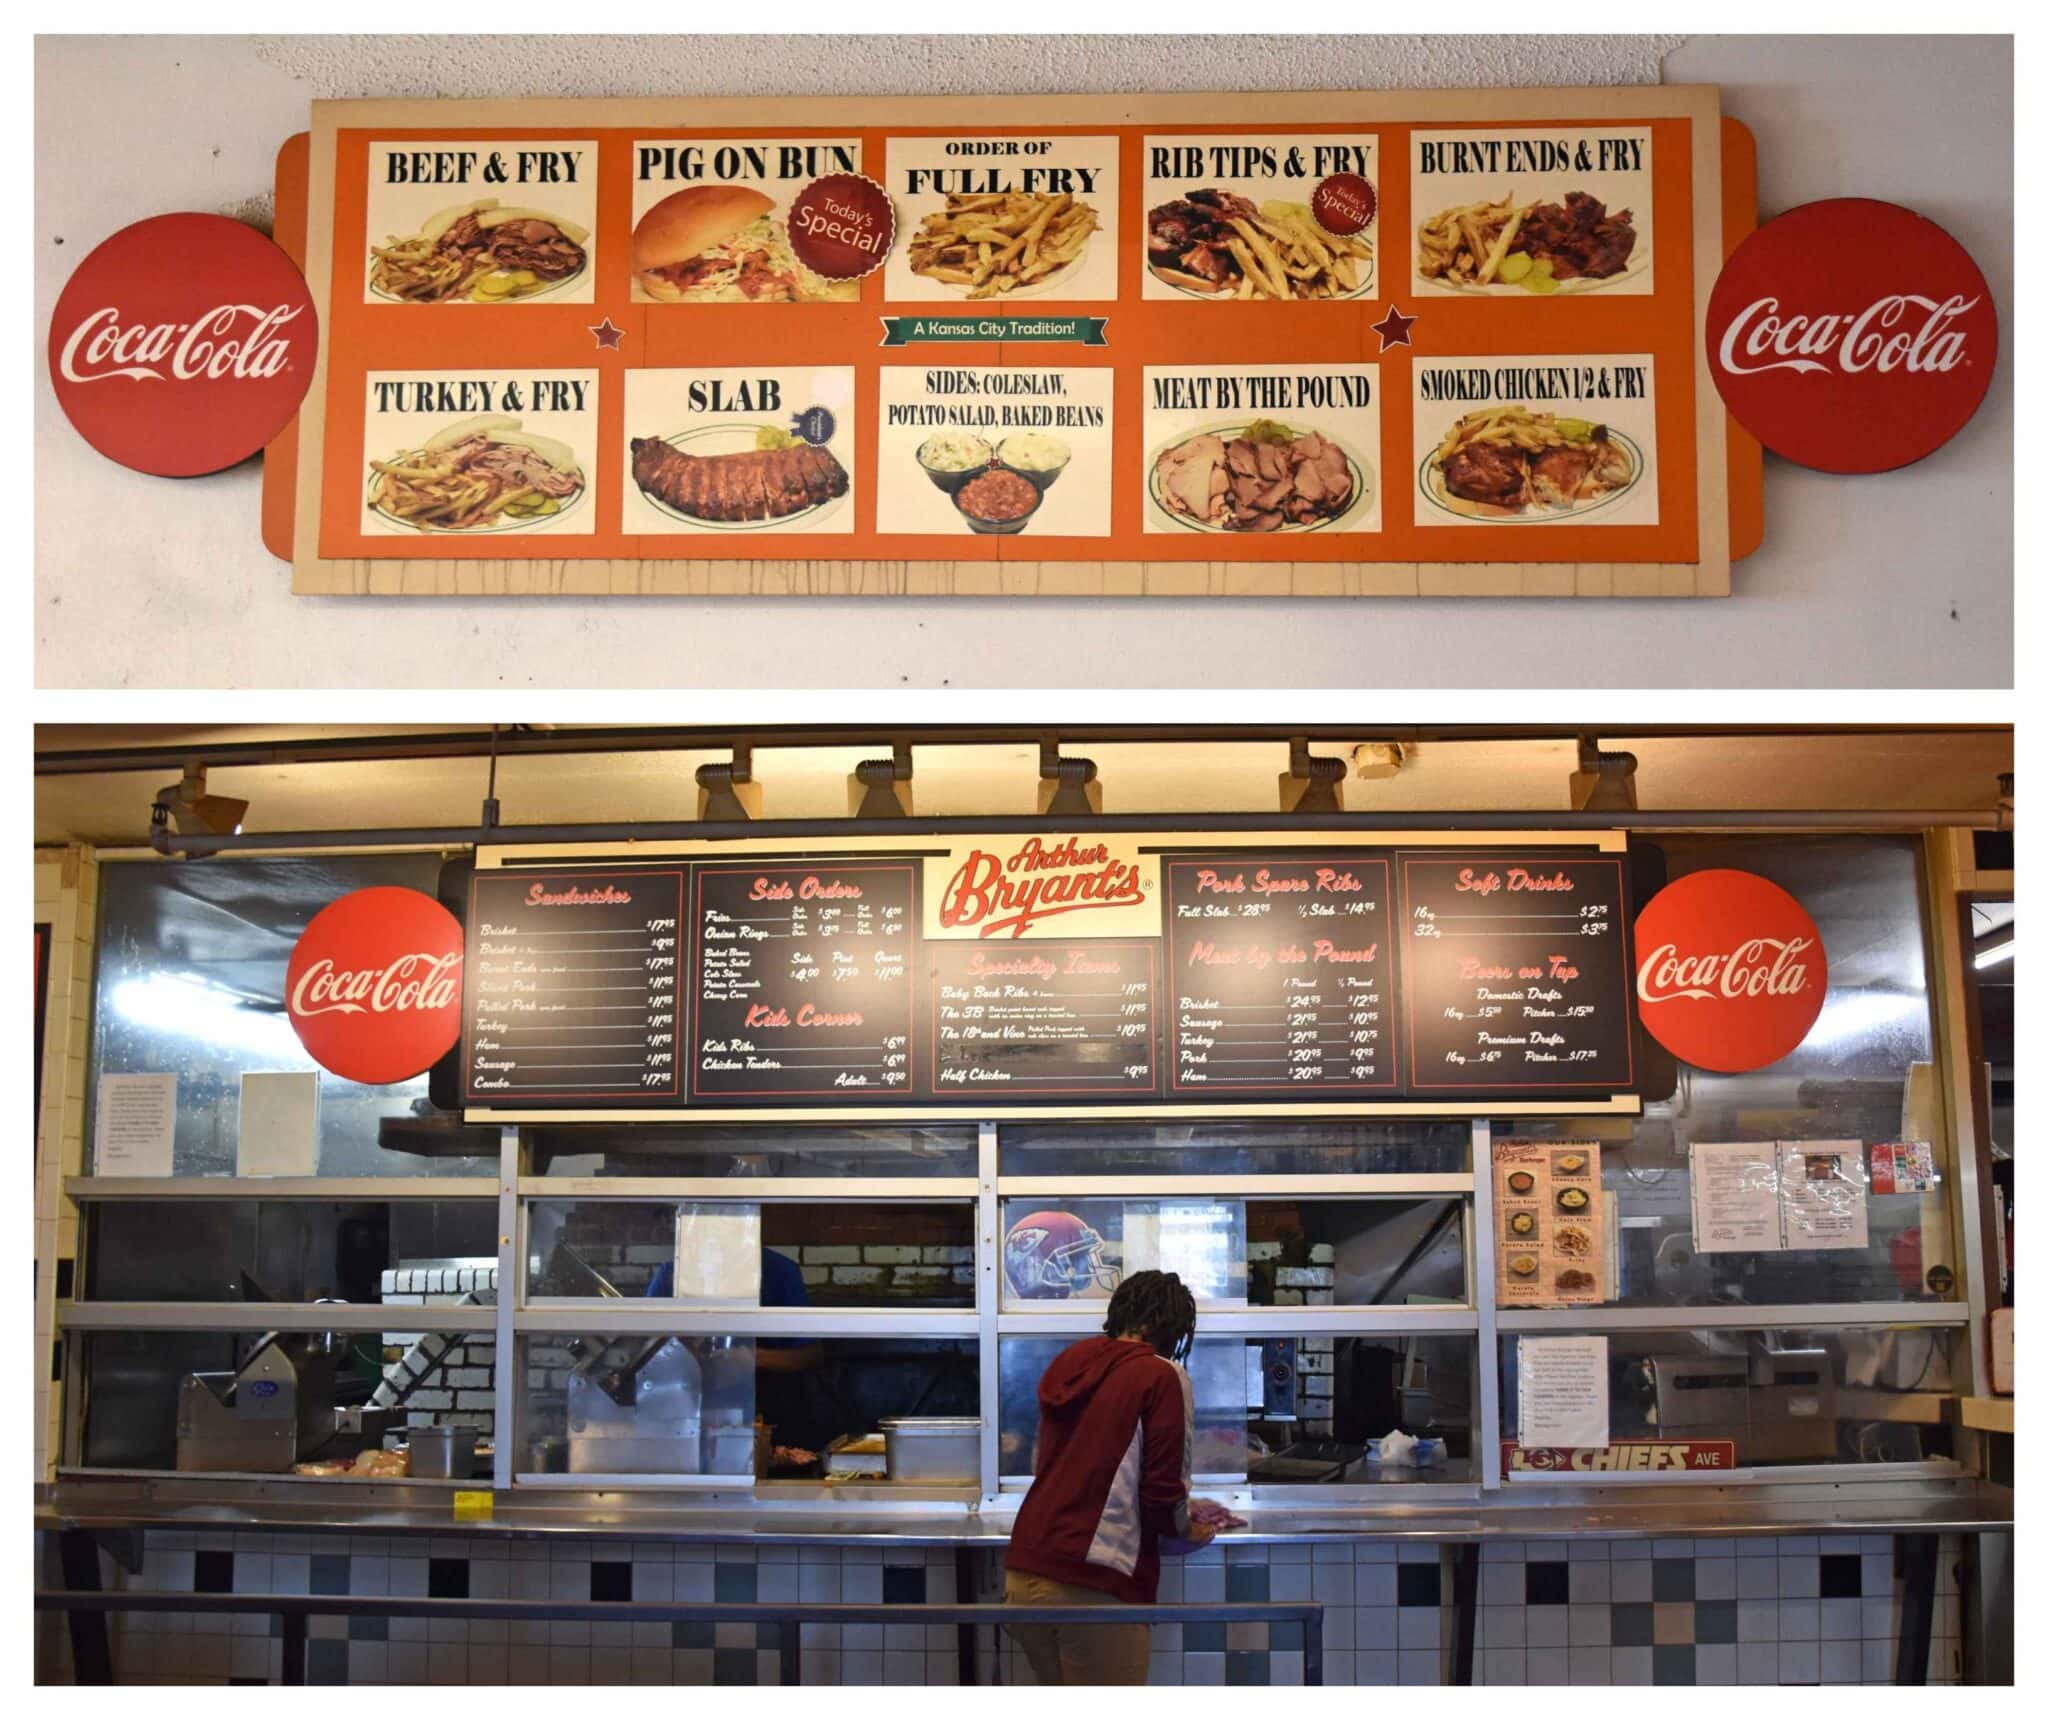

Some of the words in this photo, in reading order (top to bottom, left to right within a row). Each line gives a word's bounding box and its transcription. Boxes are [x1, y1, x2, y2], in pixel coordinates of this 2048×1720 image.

[945, 141, 1019, 156] ORDER
[1024, 141, 1053, 156] OF
[1420, 141, 1500, 174] BURNT
[1506, 140, 1569, 172] ENDS
[1574, 139, 1593, 171] &
[1598, 138, 1644, 171] FRY
[385, 151, 478, 183] BEEF
[482, 151, 509, 183] &
[517, 151, 584, 183] FRY
[637, 146, 704, 180] PIG
[714, 146, 768, 179] ON
[777, 145, 857, 179] BUN
[1150, 146, 1204, 179] RIB
[1209, 145, 1278, 179] TIPS
[1283, 146, 1307, 178] &
[1312, 144, 1372, 177] FRY
[906, 168, 1013, 195] FULL
[1020, 167, 1102, 194] FRY
[823, 197, 873, 228] Today's
[1318, 187, 1371, 226] Special
[796, 205, 884, 254] Special
[913, 321, 925, 336] A
[928, 320, 975, 336] Kansas
[978, 320, 1006, 338] City
[1009, 320, 1075, 336] Tradition!
[1719, 294, 1981, 375] Coca-Cola
[60, 304, 306, 383] Coca-Cola
[688, 379, 781, 412] SLAB
[926, 370, 980, 395] SIDES:
[983, 373, 1067, 398] COLESLAW,
[1152, 376, 1212, 409] MEAT
[1215, 376, 1245, 408] BY
[1246, 375, 1295, 408] THE
[1298, 374, 1371, 408] POUND
[1421, 369, 1491, 401] SMOKED
[1495, 368, 1569, 400] CHICKEN
[1572, 367, 1594, 402] 1/2
[1598, 368, 1611, 398] &
[1614, 367, 1647, 399] FRY
[374, 381, 497, 413] TURKEY
[501, 381, 525, 413] &
[530, 380, 590, 412] FRY
[888, 403, 946, 426] POTATO
[948, 404, 998, 427] SALAD,
[1002, 405, 1053, 427] BAKED
[1056, 406, 1104, 428] BEANS
[1007, 836, 1109, 872] Arthur
[748, 877, 794, 901] Side
[799, 876, 863, 900] Orders
[1196, 869, 1247, 893] Pork
[1251, 868, 1310, 897] Spare
[1315, 868, 1362, 892] Ribs
[1454, 868, 1501, 896] Soft
[1506, 868, 1574, 891] Drinks
[524, 882, 632, 906] Sandwiches
[939, 850, 1145, 939] Bryant's
[704, 910, 731, 922] Fries
[1177, 904, 1202, 917] Full
[1203, 903, 1231, 917] Slab
[1309, 903, 1335, 916] Slab
[480, 924, 517, 937] Brisket
[704, 926, 737, 939] Onion
[739, 925, 769, 941] Rings
[1188, 941, 1240, 968] Meat
[1276, 944, 1307, 963] the
[1312, 939, 1377, 963] Pound
[1517, 966, 1543, 980] on
[1548, 955, 1579, 983] Tap
[1637, 937, 1814, 1003] Coca-Cola
[292, 952, 464, 1016] Coca-Cola
[941, 986, 969, 1001] Baby
[974, 985, 1000, 999] Back
[1003, 985, 1029, 999] Ribs
[1477, 987, 1525, 1001] Domestic
[1527, 987, 1563, 1002] Drafts
[941, 1005, 960, 1020] The
[1179, 997, 1219, 1009] Brisket
[1522, 1006, 1556, 1018] Pitcher
[475, 1018, 509, 1034] Turkey
[744, 1004, 791, 1027] Kids
[796, 1004, 863, 1027] Corner
[1179, 1015, 1223, 1030] Sausage
[941, 1026, 960, 1040] The
[981, 1027, 1002, 1039] and
[1003, 1025, 1025, 1039] Vine
[1179, 1033, 1215, 1048] Turkey
[1477, 1031, 1527, 1045] Premium
[1529, 1031, 1565, 1046] Drafts
[475, 1038, 500, 1051] Ham
[702, 1040, 727, 1052] Kids
[730, 1039, 755, 1052] Ribs
[1524, 1050, 1557, 1062] Pitcher
[473, 1057, 516, 1072] Sausage
[702, 1057, 743, 1070] Chicken
[746, 1056, 782, 1069] Tenders
[1180, 1050, 1208, 1063] Pork
[473, 1076, 510, 1089] Combo
[834, 1072, 867, 1086] Adult
[941, 1068, 966, 1083] Half
[969, 1067, 1011, 1081] Chicken
[1180, 1069, 1207, 1082] Ham
[1571, 1445, 1690, 1471] CHIEFS
[1694, 1452, 1720, 1466] AVE
